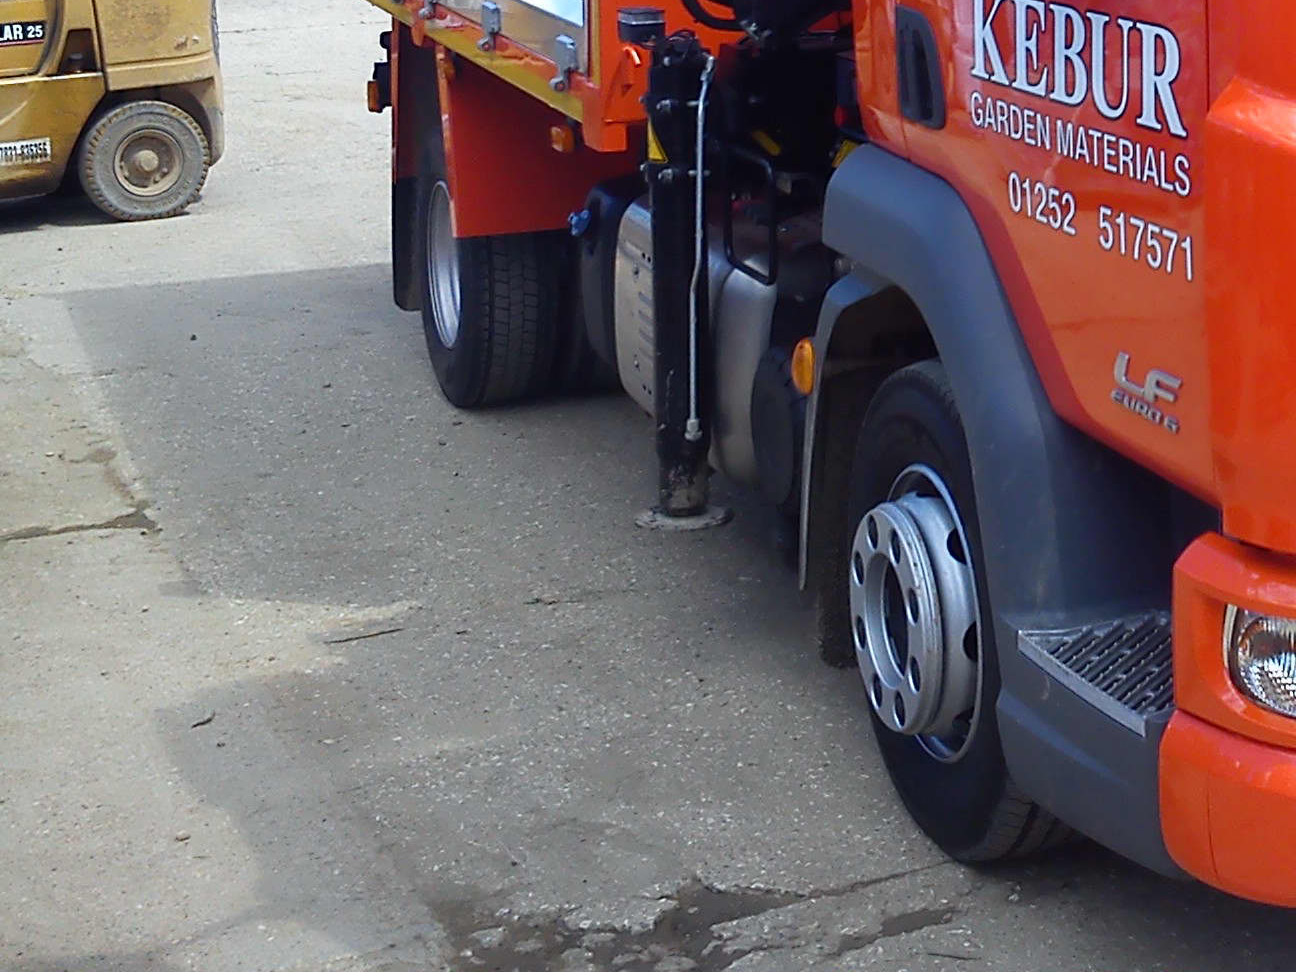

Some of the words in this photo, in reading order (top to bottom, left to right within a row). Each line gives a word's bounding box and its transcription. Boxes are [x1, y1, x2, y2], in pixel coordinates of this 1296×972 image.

[0, 24, 24, 41] AR
[26, 25, 44, 39] 25
[969, 90, 1052, 152] GARDEN
[1055, 118, 1192, 198] MATERIALS
[1008, 171, 1077, 236] 01252
[1098, 205, 1193, 282] 517571
[1113, 350, 1182, 403] LF
